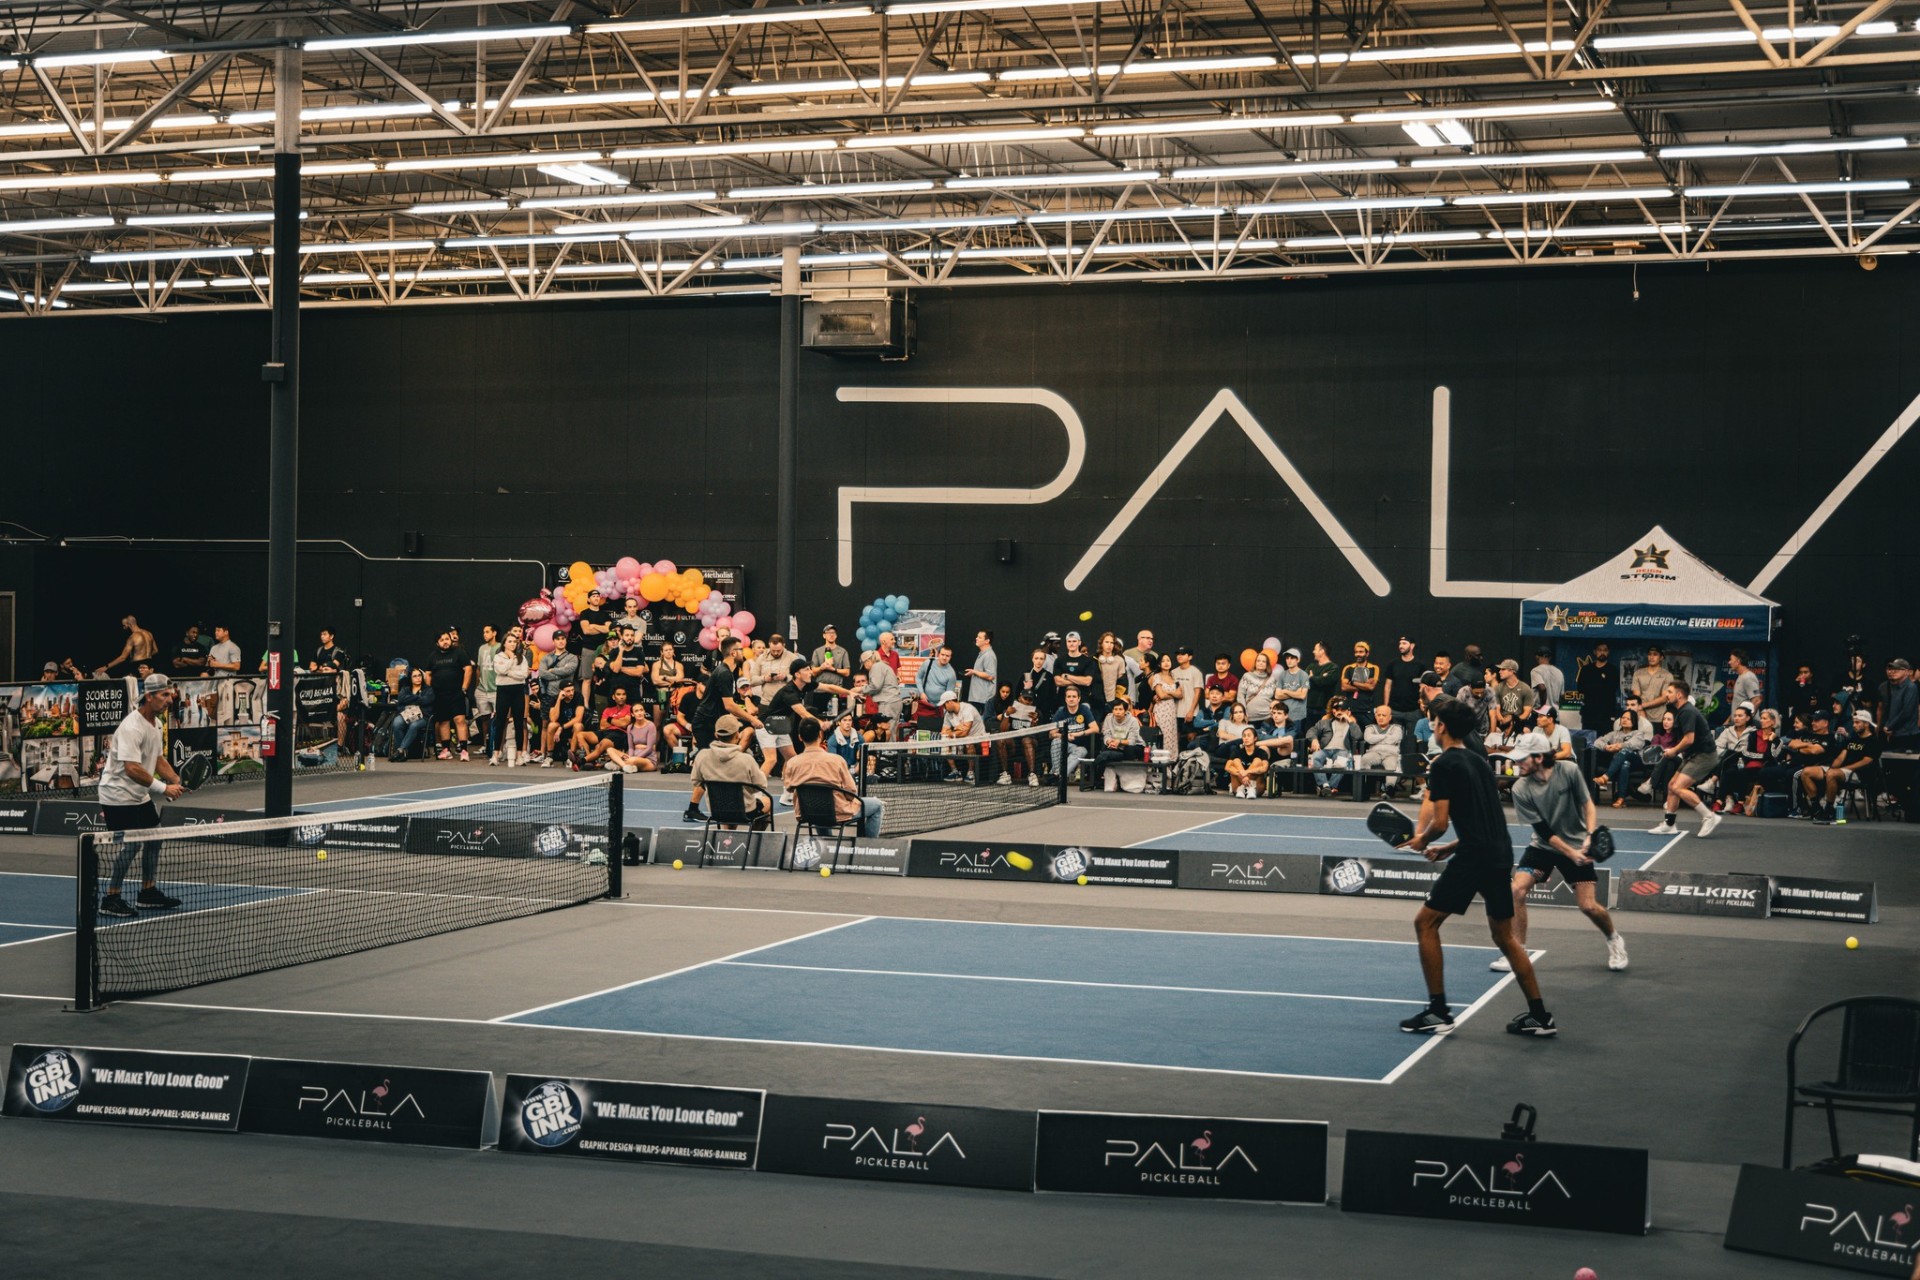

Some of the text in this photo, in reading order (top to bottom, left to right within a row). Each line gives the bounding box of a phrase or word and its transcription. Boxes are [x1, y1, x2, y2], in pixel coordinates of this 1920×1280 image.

[1620, 573, 1676, 581] STORM
[1567, 616, 1608, 625] STORM
[1614, 616, 1642, 625] CLEAN
[1643, 616, 1677, 626] ENERGY
[1688, 617, 1744, 628] EVERYBODY.
[86, 689, 123, 701] SCORE BIG
[352, 678, 358, 696] 6
[85, 701, 123, 711] ON AND OFF
[86, 711, 123, 721] THE COURT
[64, 813, 107, 826] PAL
[437, 830, 500, 845] PALA
[940, 852, 1010, 867] PALA
[1057, 852, 1082, 868] GBI
[1060, 861, 1084, 877] INK
[1211, 863, 1286, 880] PALA
[1334, 863, 1360, 880] GBI
[1337, 873, 1363, 889] INK
[1664, 885, 1756, 900] SELKIRK
[1792, 888, 1810, 898] MAKE
[1811, 889, 1824, 898] YOU
[1824, 890, 1841, 900] LOOK
[30, 1059, 71, 1088] GBI
[115, 1069, 144, 1085] MAKE
[145, 1071, 166, 1086] YOU
[168, 1072, 194, 1088] LOOK
[33, 1073, 78, 1104] INK
[77, 1104, 103, 1114] GRAPHIC
[298, 1086, 425, 1119] PALA
[526, 1091, 570, 1122] GBI
[618, 1103, 650, 1120] MAKE
[651, 1105, 673, 1122] YOU
[675, 1107, 704, 1124] LOOK
[326, 1116, 393, 1130] PICKLEBALL
[531, 1106, 578, 1139] INK
[561, 1123, 581, 1136] .com
[580, 1140, 609, 1150] GRAPHIC
[823, 1123, 966, 1158] PALA
[855, 1156, 929, 1170] PICKLEBALL
[1105, 1139, 1258, 1172] PALA
[1141, 1172, 1220, 1185] PICKLEBALL
[1413, 1159, 1571, 1198] PALA
[1449, 1194, 1531, 1210] PICKLEBALL
[1833, 1242, 1914, 1265] PICKLEBALL
